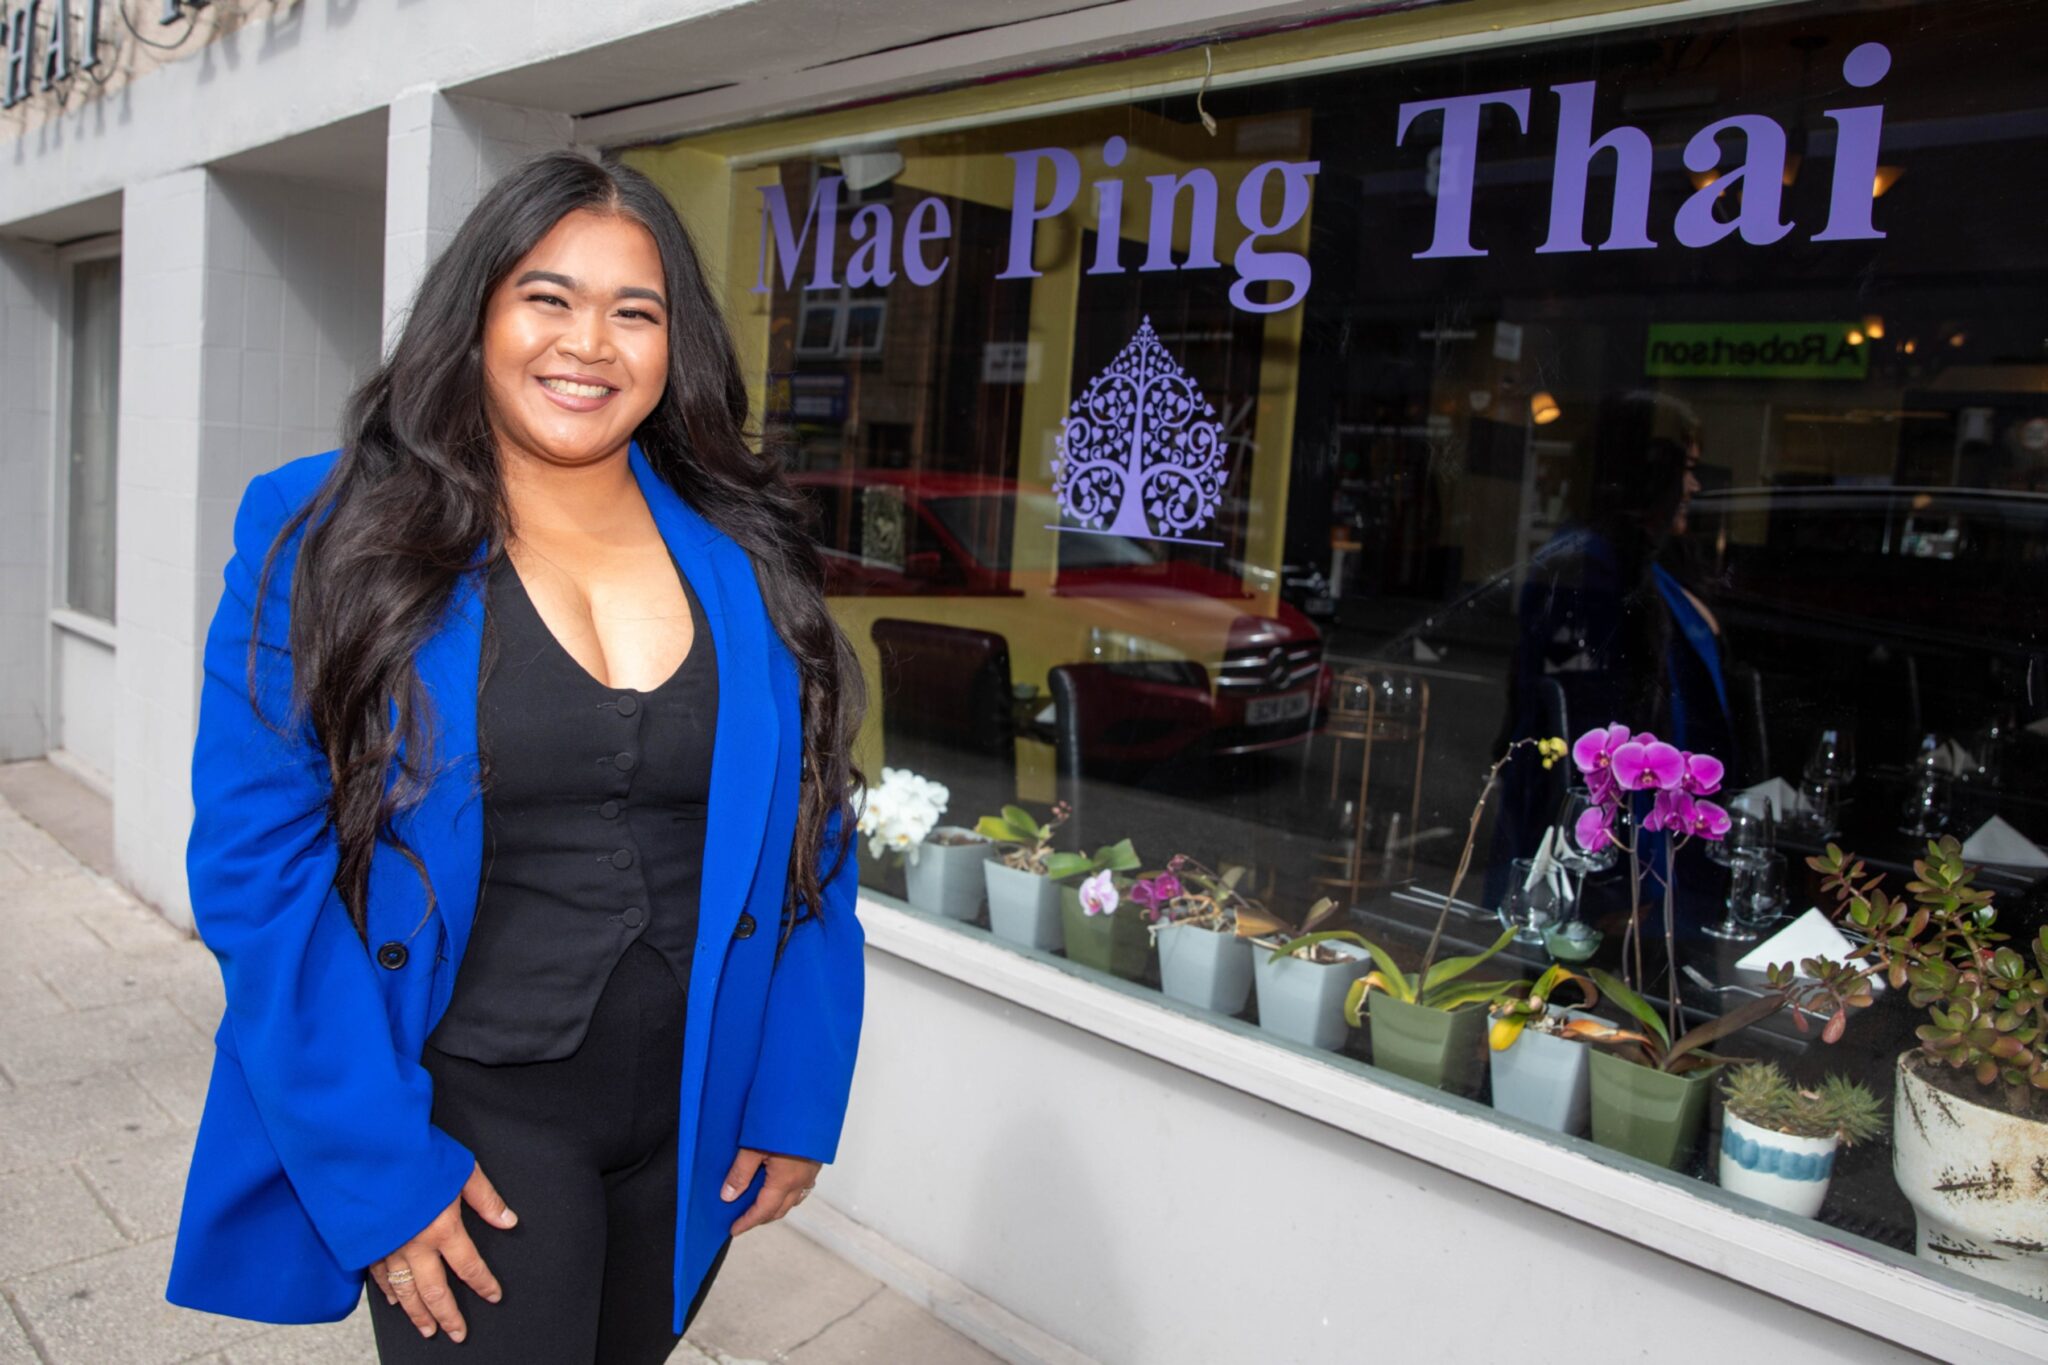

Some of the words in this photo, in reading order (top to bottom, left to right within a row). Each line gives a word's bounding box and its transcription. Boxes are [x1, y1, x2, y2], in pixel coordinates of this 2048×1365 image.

[0, 0, 101, 109] HAI
[751, 176, 952, 292] Mae
[995, 135, 1321, 314] Ping
[1396, 42, 1892, 260] Thai
